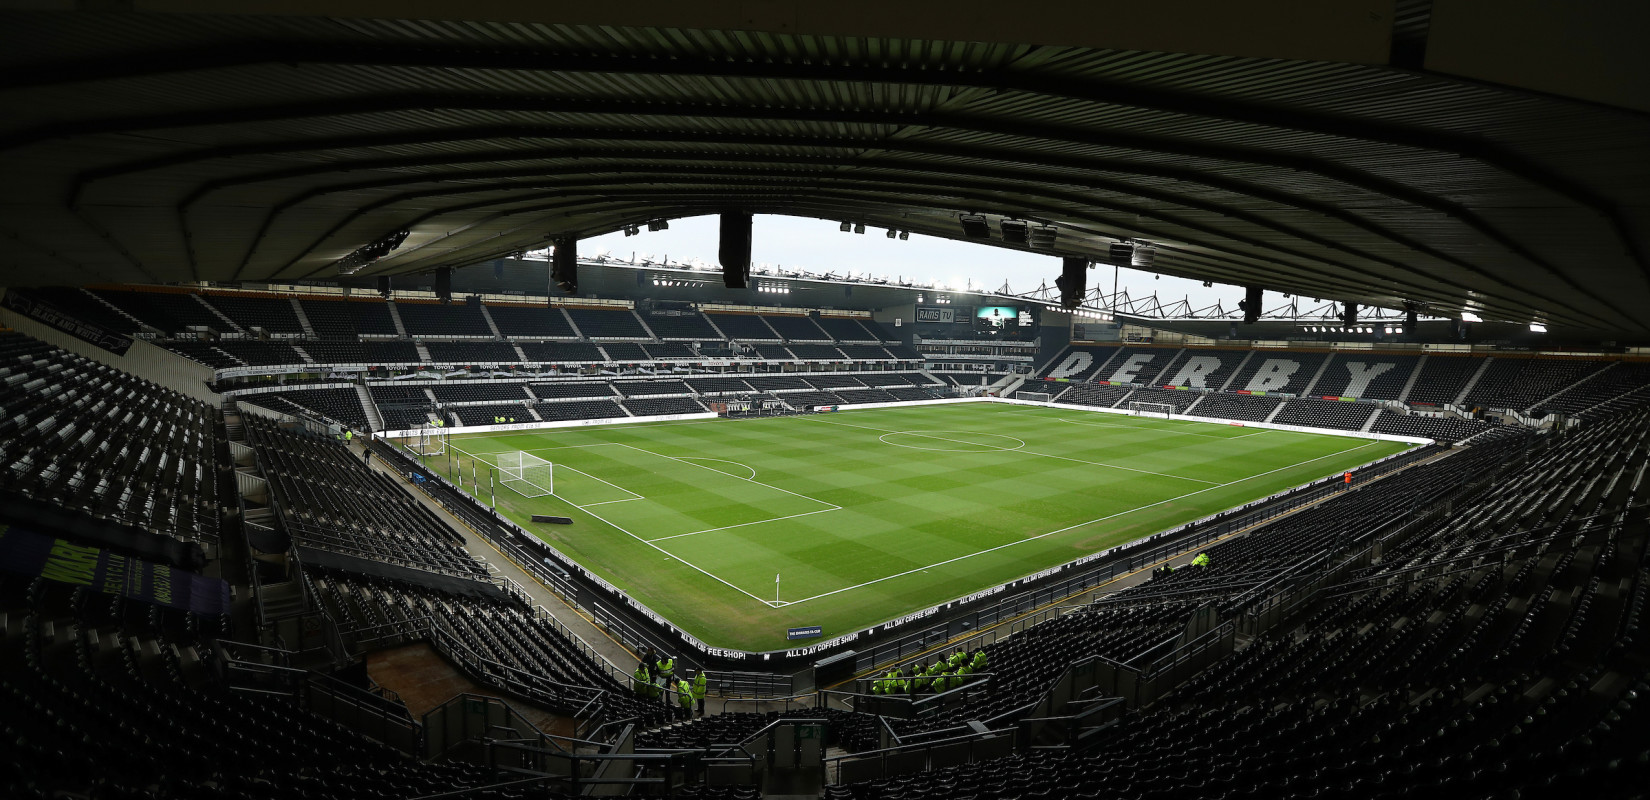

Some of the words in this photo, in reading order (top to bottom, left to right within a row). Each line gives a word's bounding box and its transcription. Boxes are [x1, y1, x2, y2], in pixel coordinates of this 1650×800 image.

[30, 307, 57, 324] BLACK
[56, 319, 77, 331] AND
[74, 325, 102, 341] WHITE
[919, 310, 940, 320] RAMS
[942, 311, 952, 320] TV
[1047, 351, 1396, 398] DERBY
[1030, 574, 1038, 582] DAY
[1038, 570, 1051, 579] COFFEE
[959, 596, 969, 605] ALL
[968, 594, 977, 603] DAY
[977, 589, 993, 599] COFFEE
[894, 619, 905, 627] DAY
[905, 612, 924, 623] COFFEE
[924, 606, 939, 617] SHOP!
[681, 632, 689, 642] ALL
[689, 638, 698, 647] DAY
[723, 650, 746, 660] SHOP!
[786, 650, 802, 658] ALL
[817, 639, 841, 652] COFFEE
[841, 633, 859, 644] SHOP!
